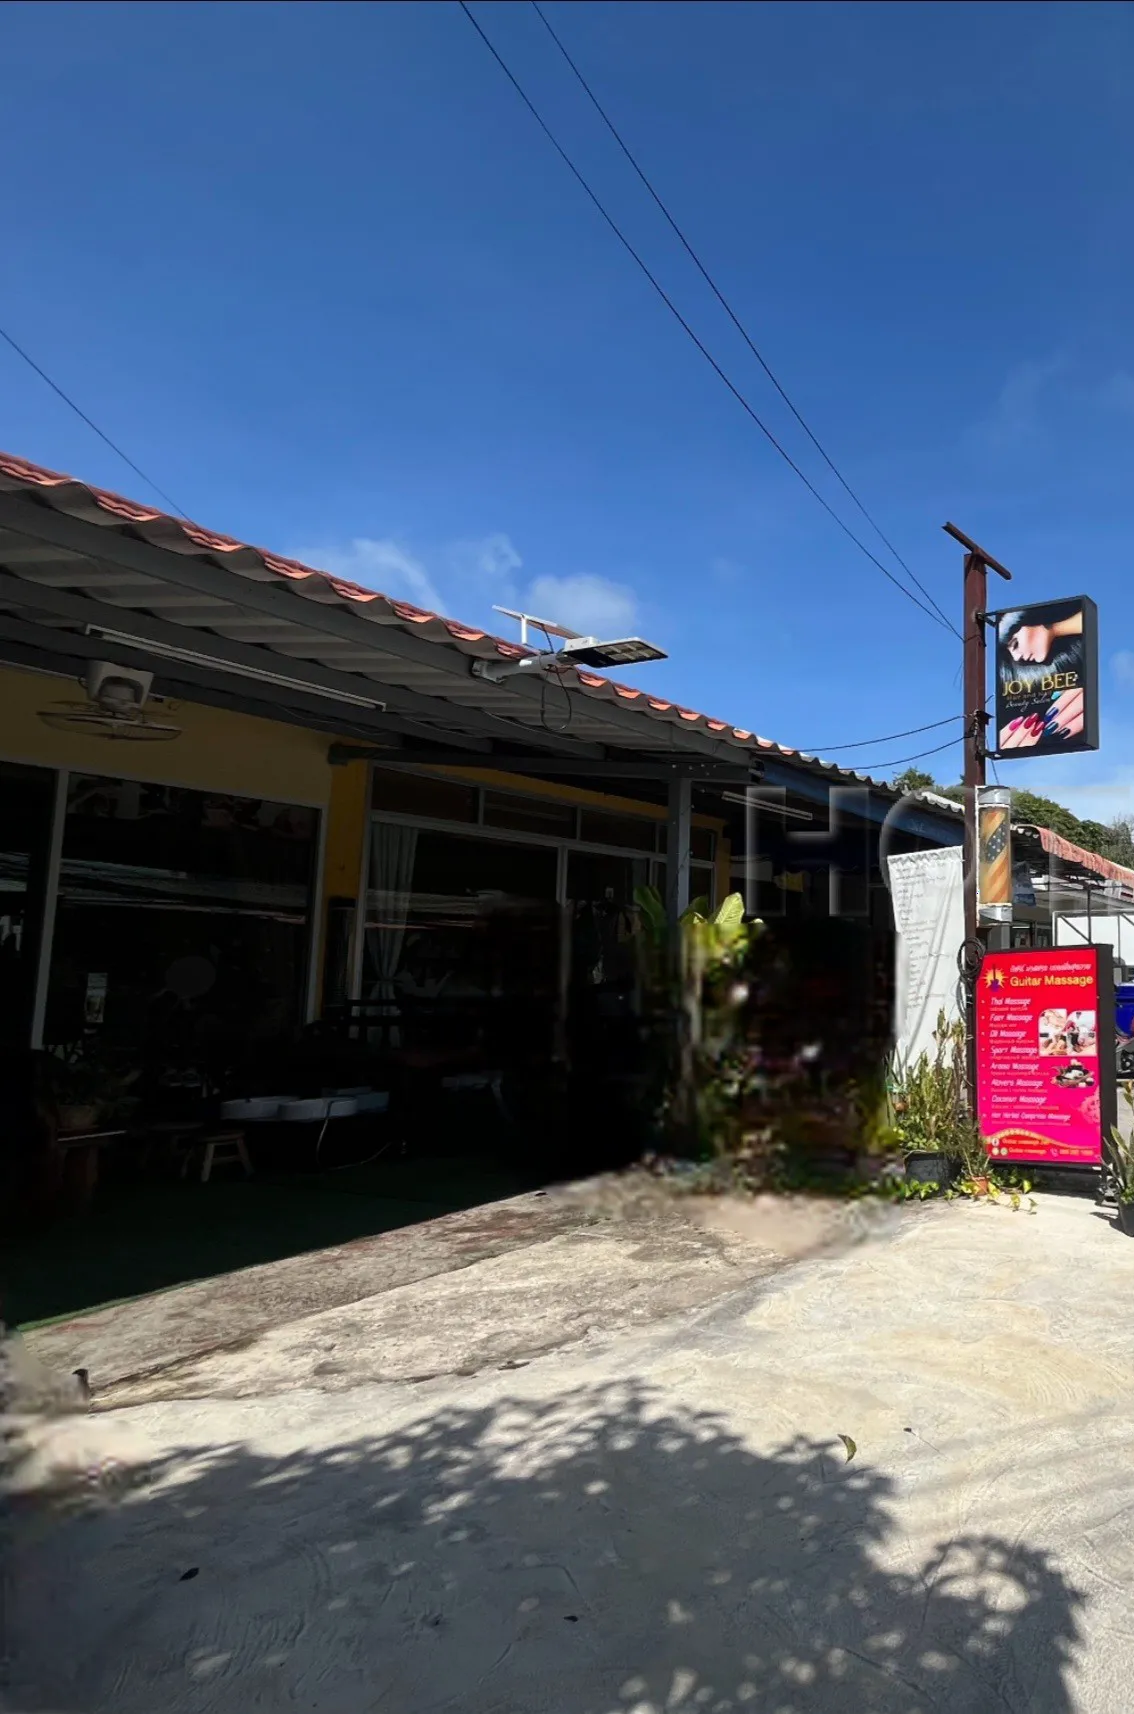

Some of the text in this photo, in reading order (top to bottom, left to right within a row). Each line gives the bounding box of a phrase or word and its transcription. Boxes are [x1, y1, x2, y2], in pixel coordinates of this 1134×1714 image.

[1003, 671, 1077, 696] JOY BEE
[1010, 975, 1093, 987] Guitar Massage
[991, 997, 1031, 1007] Thai Massage
[1006, 1013, 1033, 1023] Massage
[999, 1030, 1027, 1040] Massage
[1010, 1045, 1038, 1056] Massage
[1012, 1062, 1039, 1073] Massage
[1016, 1078, 1043, 1088] Massage
[1019, 1095, 1047, 1105] Massage
